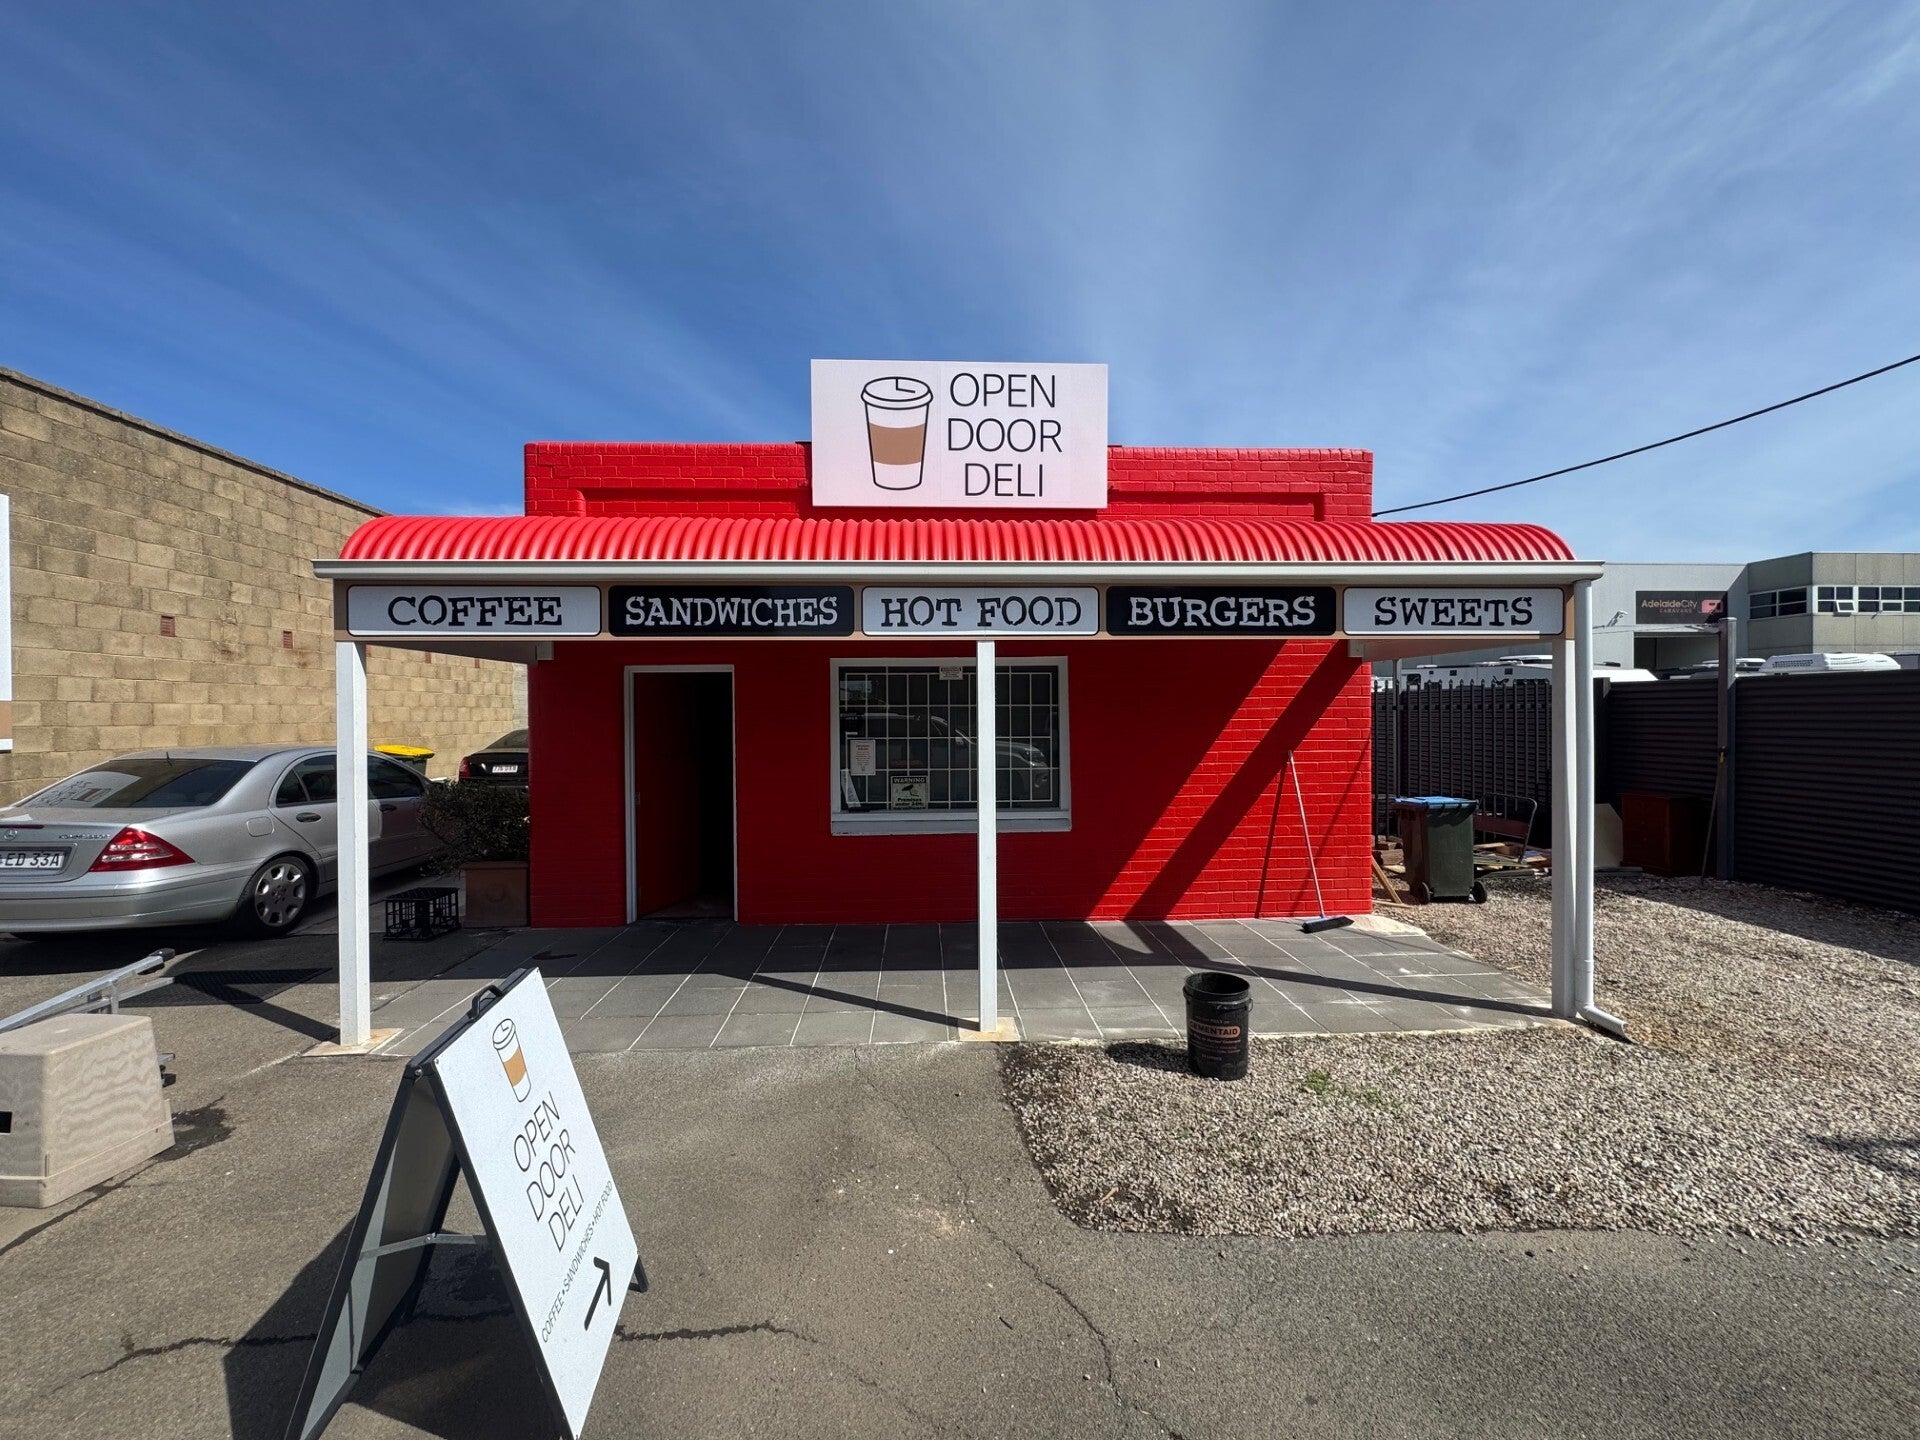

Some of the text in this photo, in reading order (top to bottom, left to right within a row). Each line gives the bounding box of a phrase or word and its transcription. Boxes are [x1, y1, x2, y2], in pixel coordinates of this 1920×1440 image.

[950, 372, 1055, 407] OPEN
[948, 417, 1062, 452] DOOR
[964, 463, 1043, 497] DELI
[388, 595, 562, 626] COFFEE
[625, 596, 838, 627] SANDWICHES
[881, 596, 1082, 627] HOT FOOD
[1128, 596, 1316, 627] BURGERS
[1375, 596, 1533, 626] SWEETS
[1190, 1022, 1238, 1035] CEMENTAID
[513, 1090, 560, 1172] OPEN
[526, 1128, 576, 1222] DOOR
[548, 1174, 584, 1252] DELI
[541, 1180, 613, 1343] COFFEE SANDWICHES HOT FOOD
